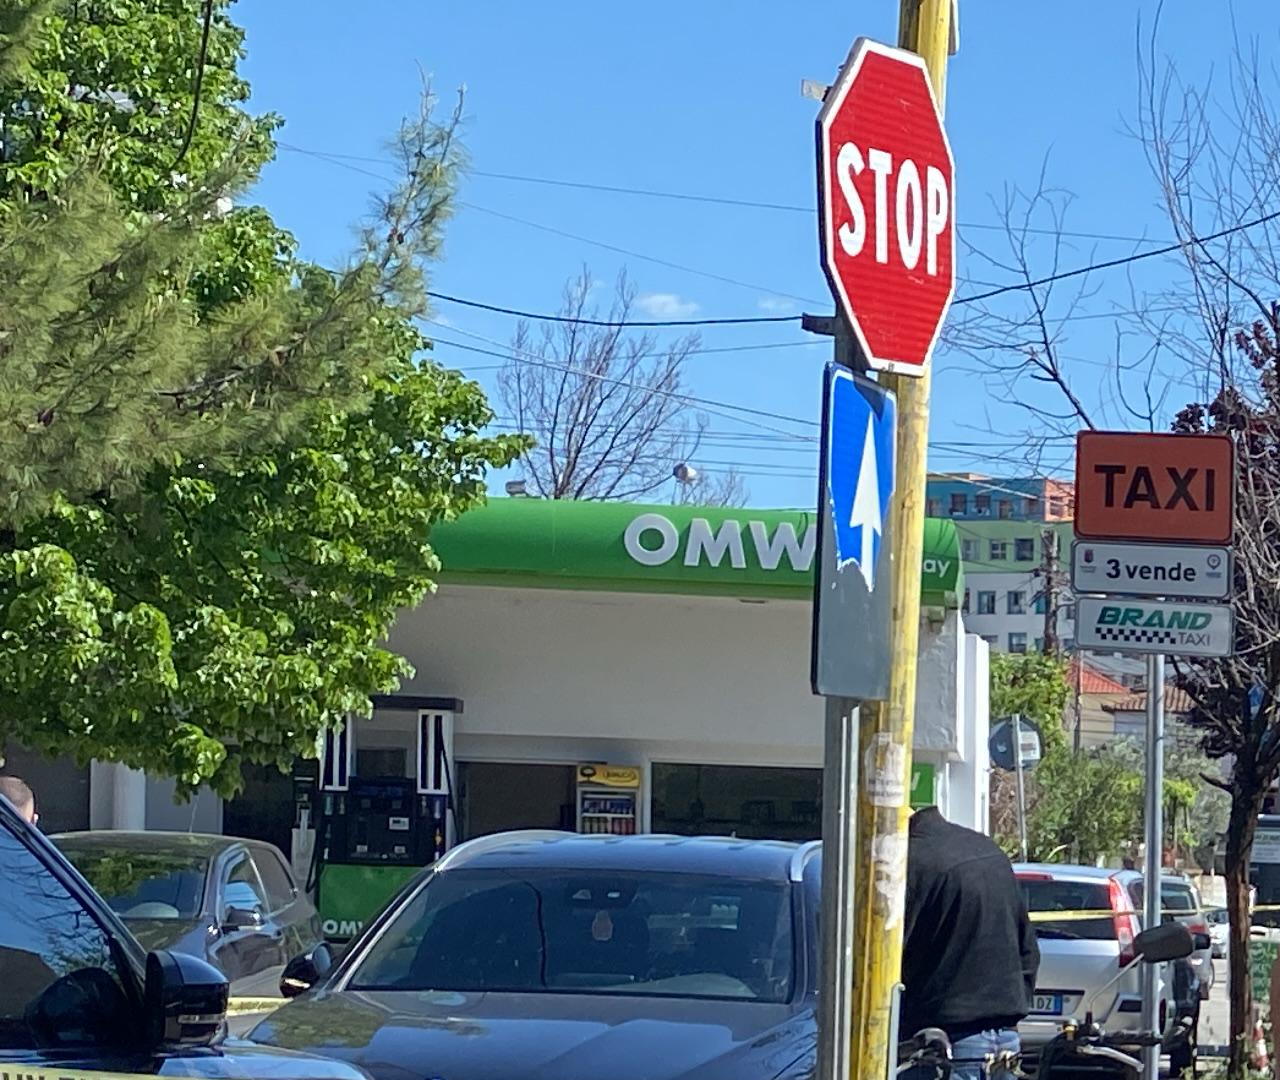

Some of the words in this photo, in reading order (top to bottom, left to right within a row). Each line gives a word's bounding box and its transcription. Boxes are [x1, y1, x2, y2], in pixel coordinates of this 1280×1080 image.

[836, 141, 949, 277] STOP
[1094, 464, 1216, 512] TAXI
[1106, 558, 1121, 579] 3
[1125, 561, 1197, 582] vende
[1097, 606, 1213, 631] BRAND
[1178, 632, 1211, 647] TAXI
